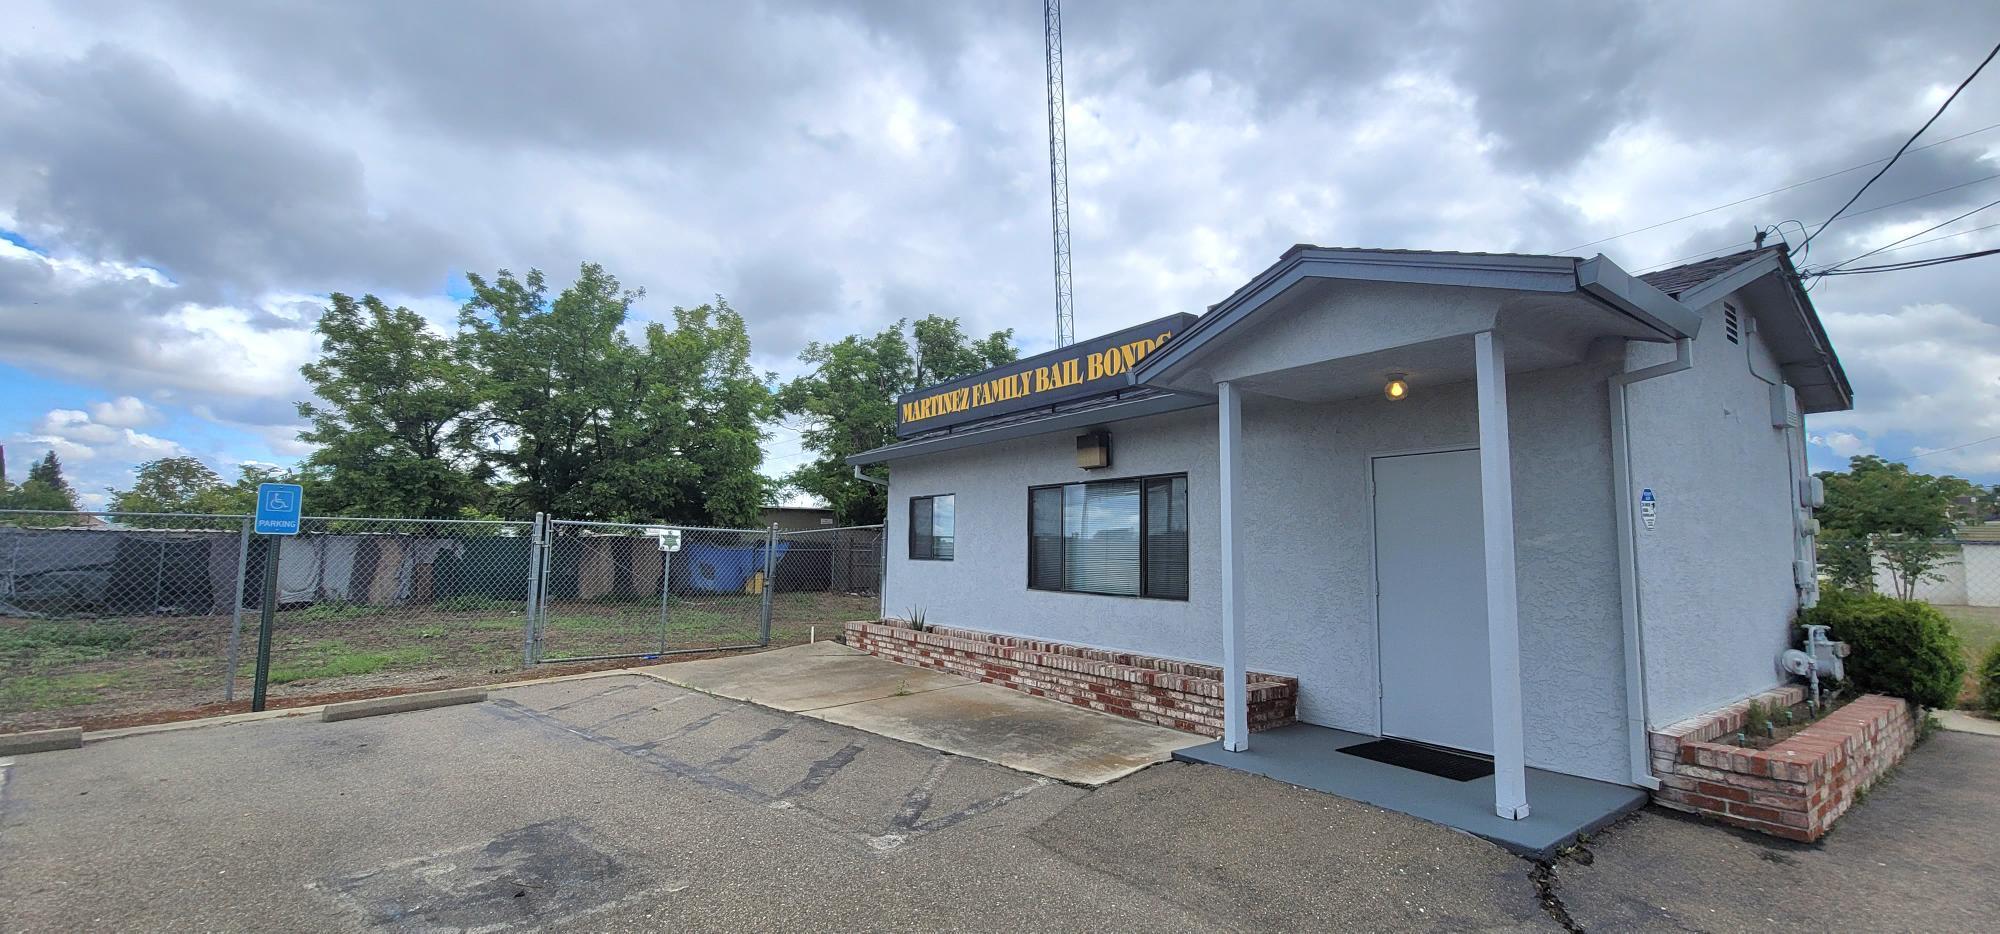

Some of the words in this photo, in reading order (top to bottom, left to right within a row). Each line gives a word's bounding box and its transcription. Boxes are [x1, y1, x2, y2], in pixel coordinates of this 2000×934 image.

[901, 387, 970, 424] MARTINEZ
[972, 372, 1034, 408] FAMILY
[1035, 358, 1085, 393] BAIL
[258, 519, 297, 528] PARKING
